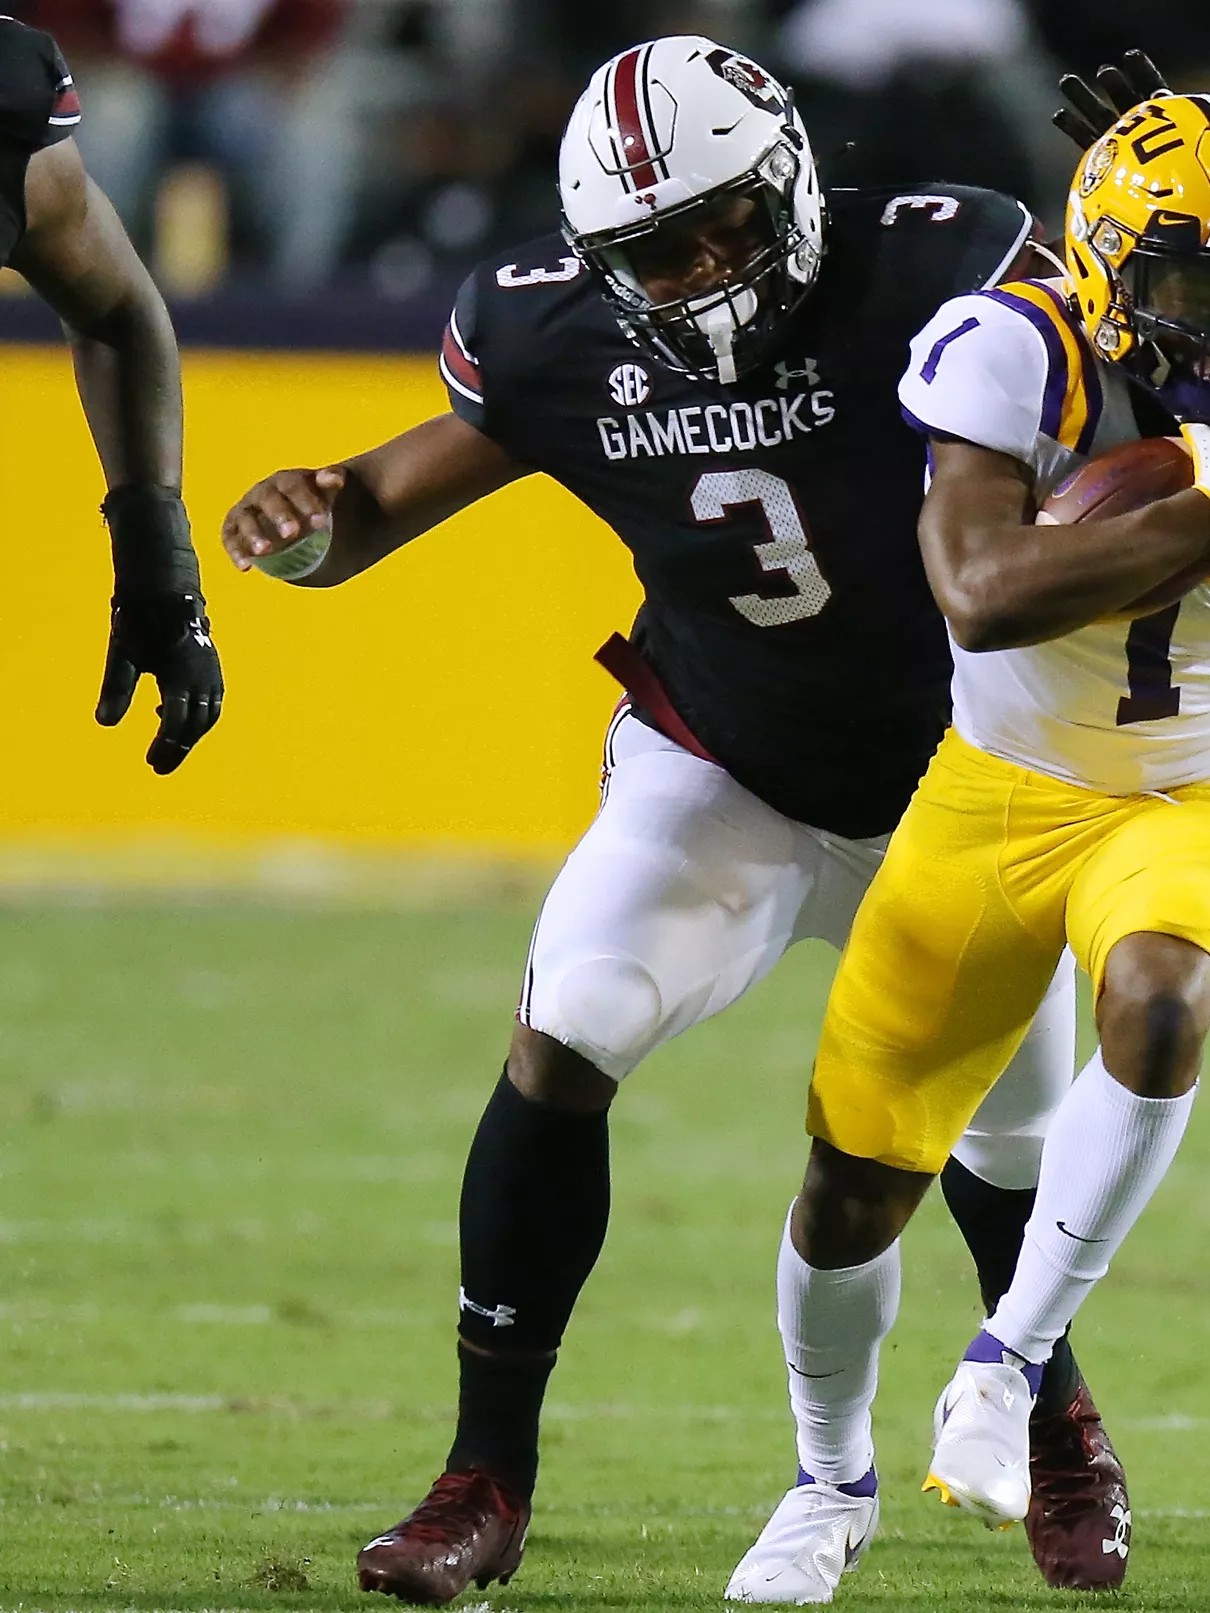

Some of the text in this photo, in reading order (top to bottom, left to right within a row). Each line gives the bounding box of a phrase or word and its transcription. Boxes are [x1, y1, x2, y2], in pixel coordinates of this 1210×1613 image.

[881, 195, 961, 226] 3
[496, 256, 581, 288] 3
[919, 316, 981, 386] 1
[607, 362, 650, 407] SEC
[596, 390, 835, 461] GAMECOCKS
[690, 468, 832, 628] 3
